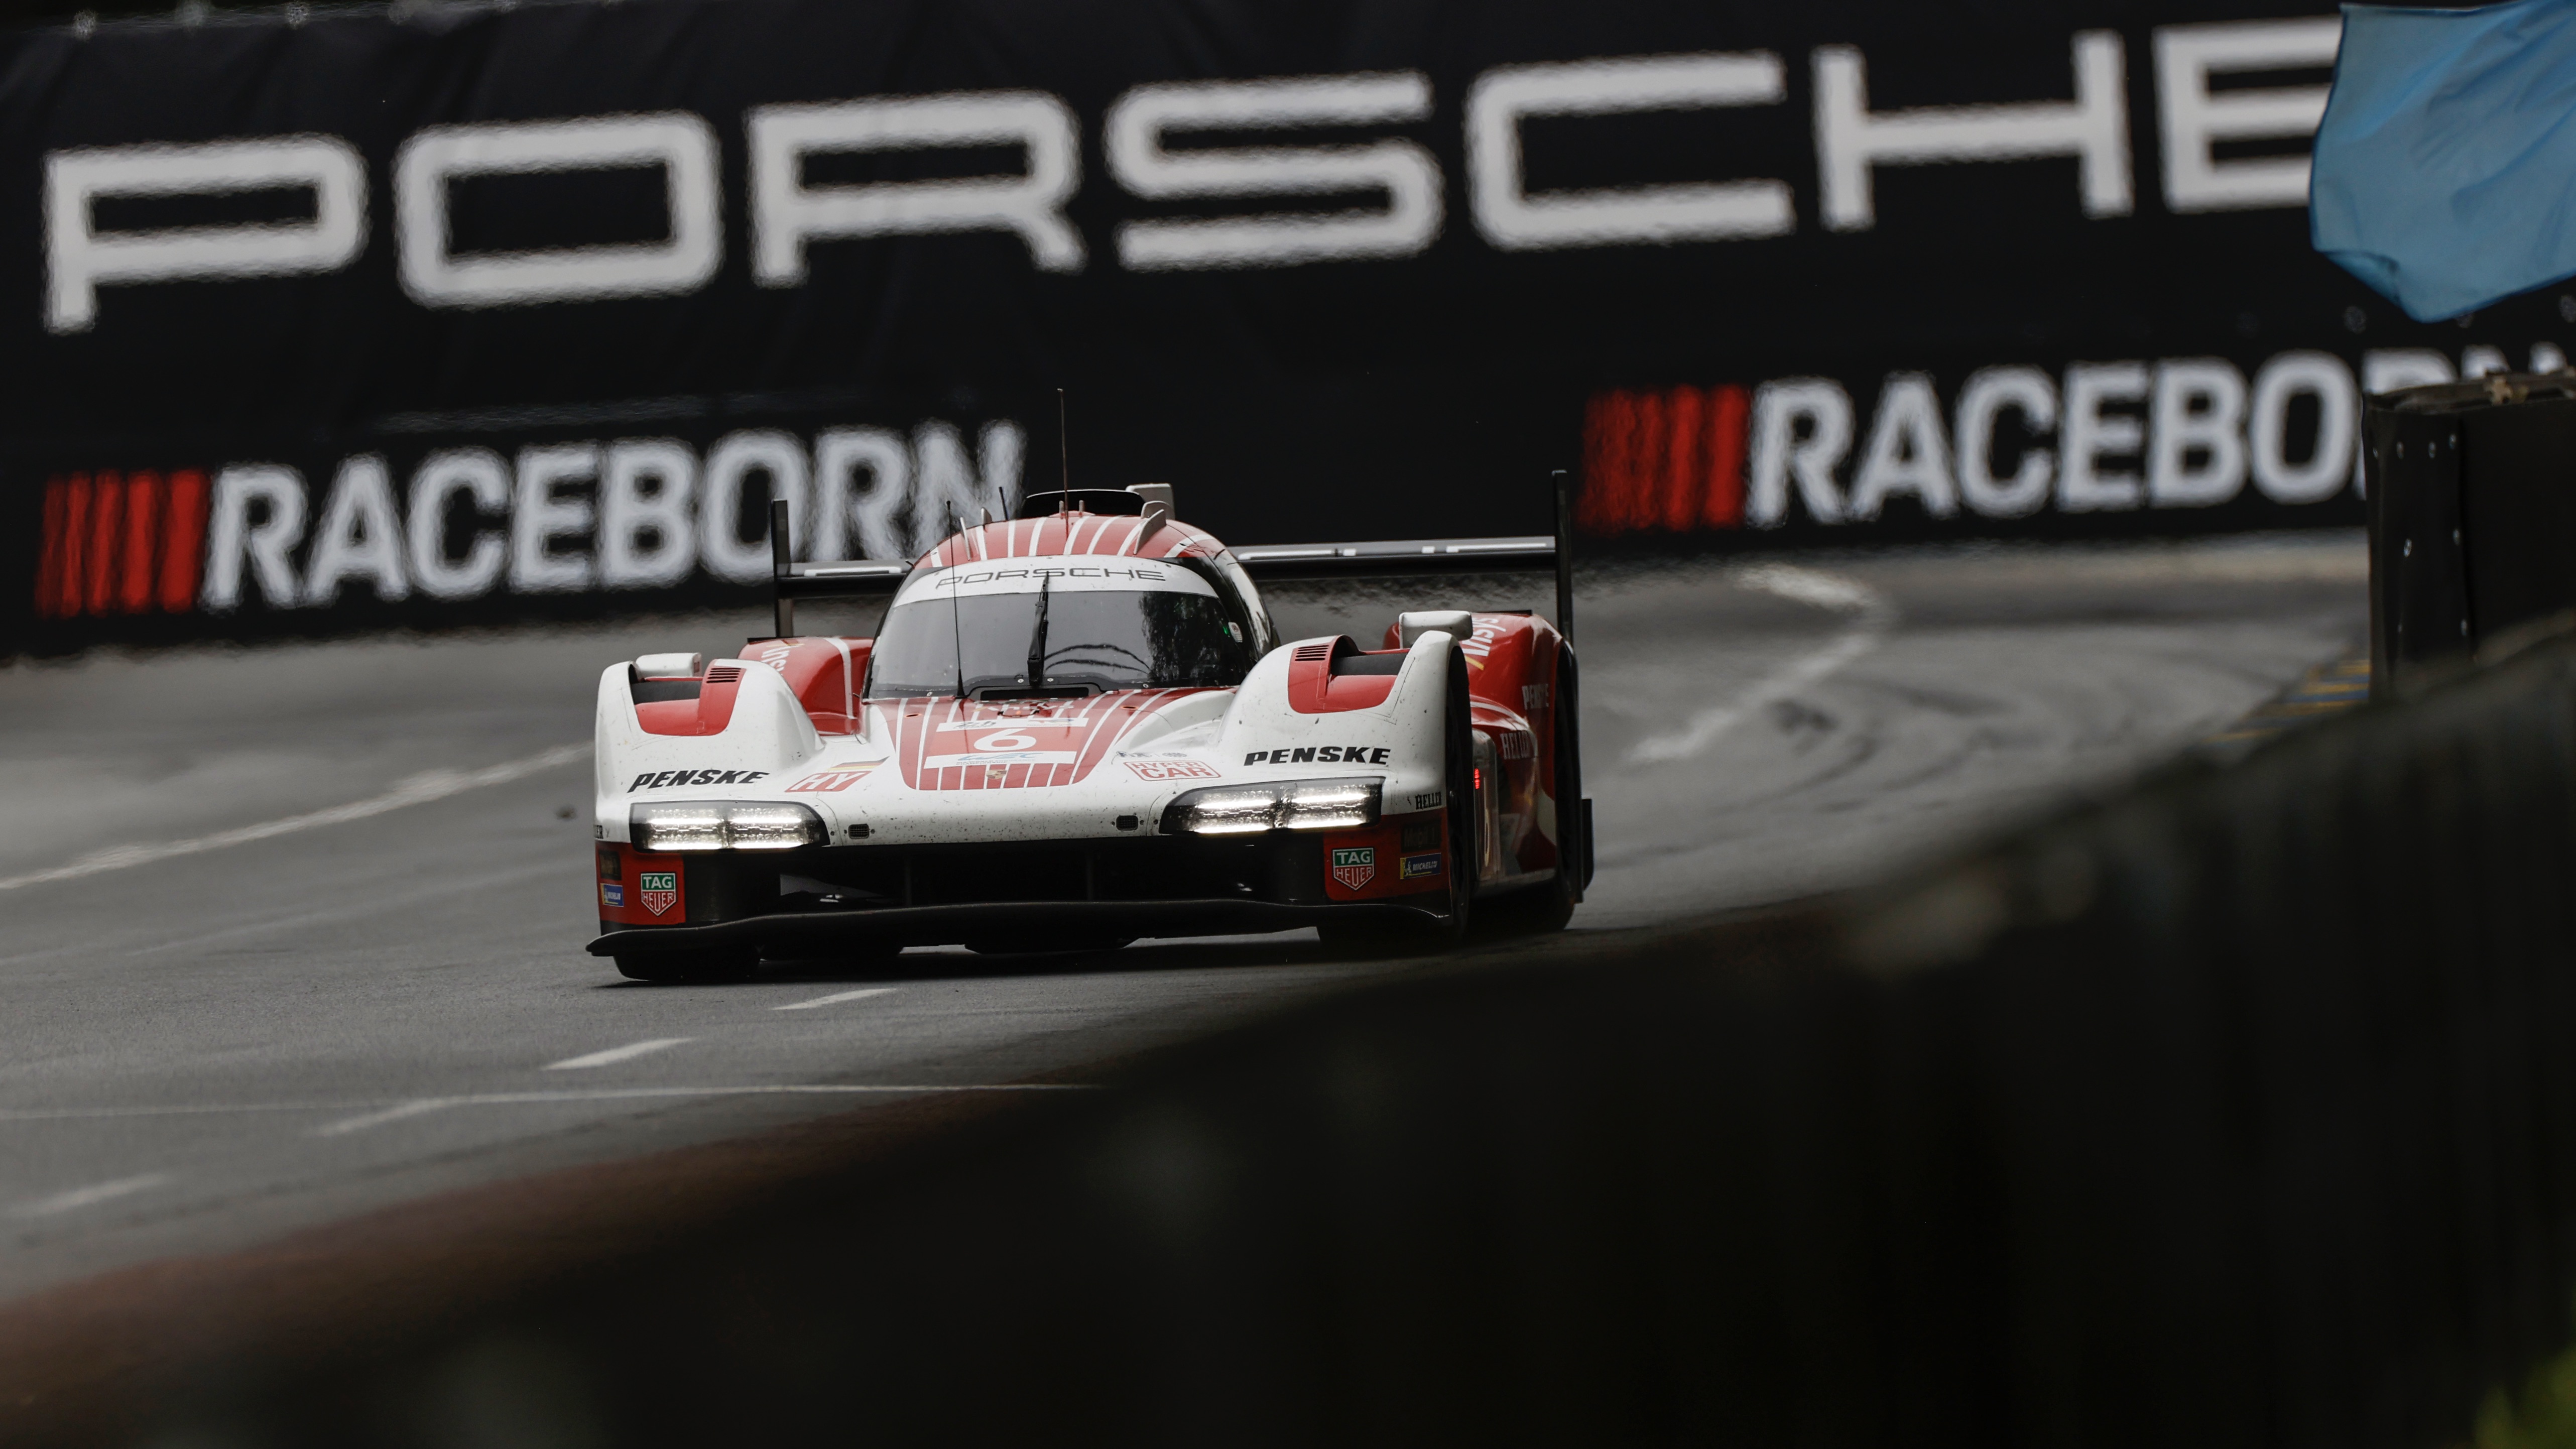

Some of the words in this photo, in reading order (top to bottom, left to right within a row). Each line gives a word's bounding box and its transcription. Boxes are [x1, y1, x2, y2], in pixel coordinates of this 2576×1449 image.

[44, 18, 2342, 335] PORSCHE
[1746, 347, 2567, 528] RACEBO
[199, 419, 1027, 614] RACEBORN
[935, 568, 1166, 589] PORSCHE
[974, 729, 1037, 751] 6
[1243, 746, 1391, 767] PENSKE
[627, 769, 770, 793] PENSKE
[792, 771, 858, 790] HY
[1140, 767, 1214, 779] CAR
[1336, 851, 1371, 864] TAG
[643, 876, 672, 889] TAG
[1336, 867, 1372, 887] HEUER
[643, 892, 673, 912] HEUER
